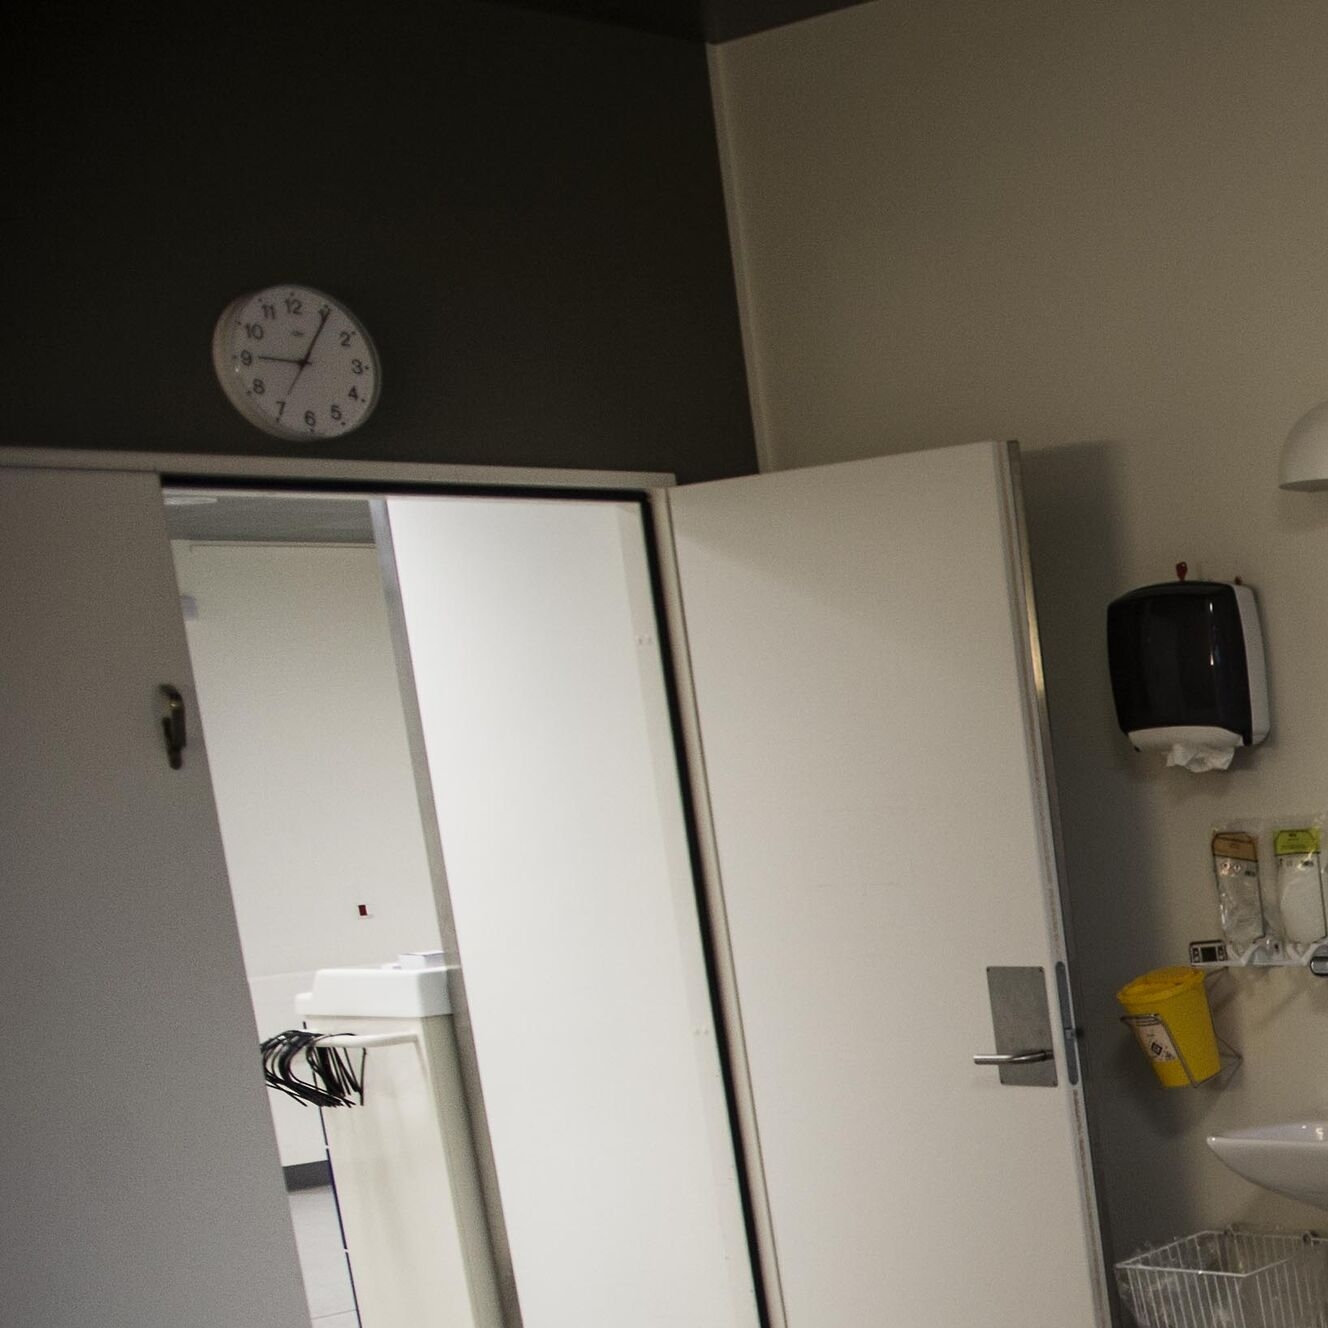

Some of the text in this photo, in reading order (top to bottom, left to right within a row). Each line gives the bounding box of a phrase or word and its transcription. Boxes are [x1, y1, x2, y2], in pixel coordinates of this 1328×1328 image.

[261, 303, 277, 320] 11
[284, 298, 303, 316] 12
[244, 322, 264, 341] 10
[339, 330, 352, 348] 2
[240, 349, 253, 367] 9
[351, 358, 364, 376] 3
[252, 378, 266, 396] 8
[348, 385, 360, 402] 4
[275, 400, 287, 417] 7
[330, 404, 343, 422] 5
[304, 409, 317, 427] 6
